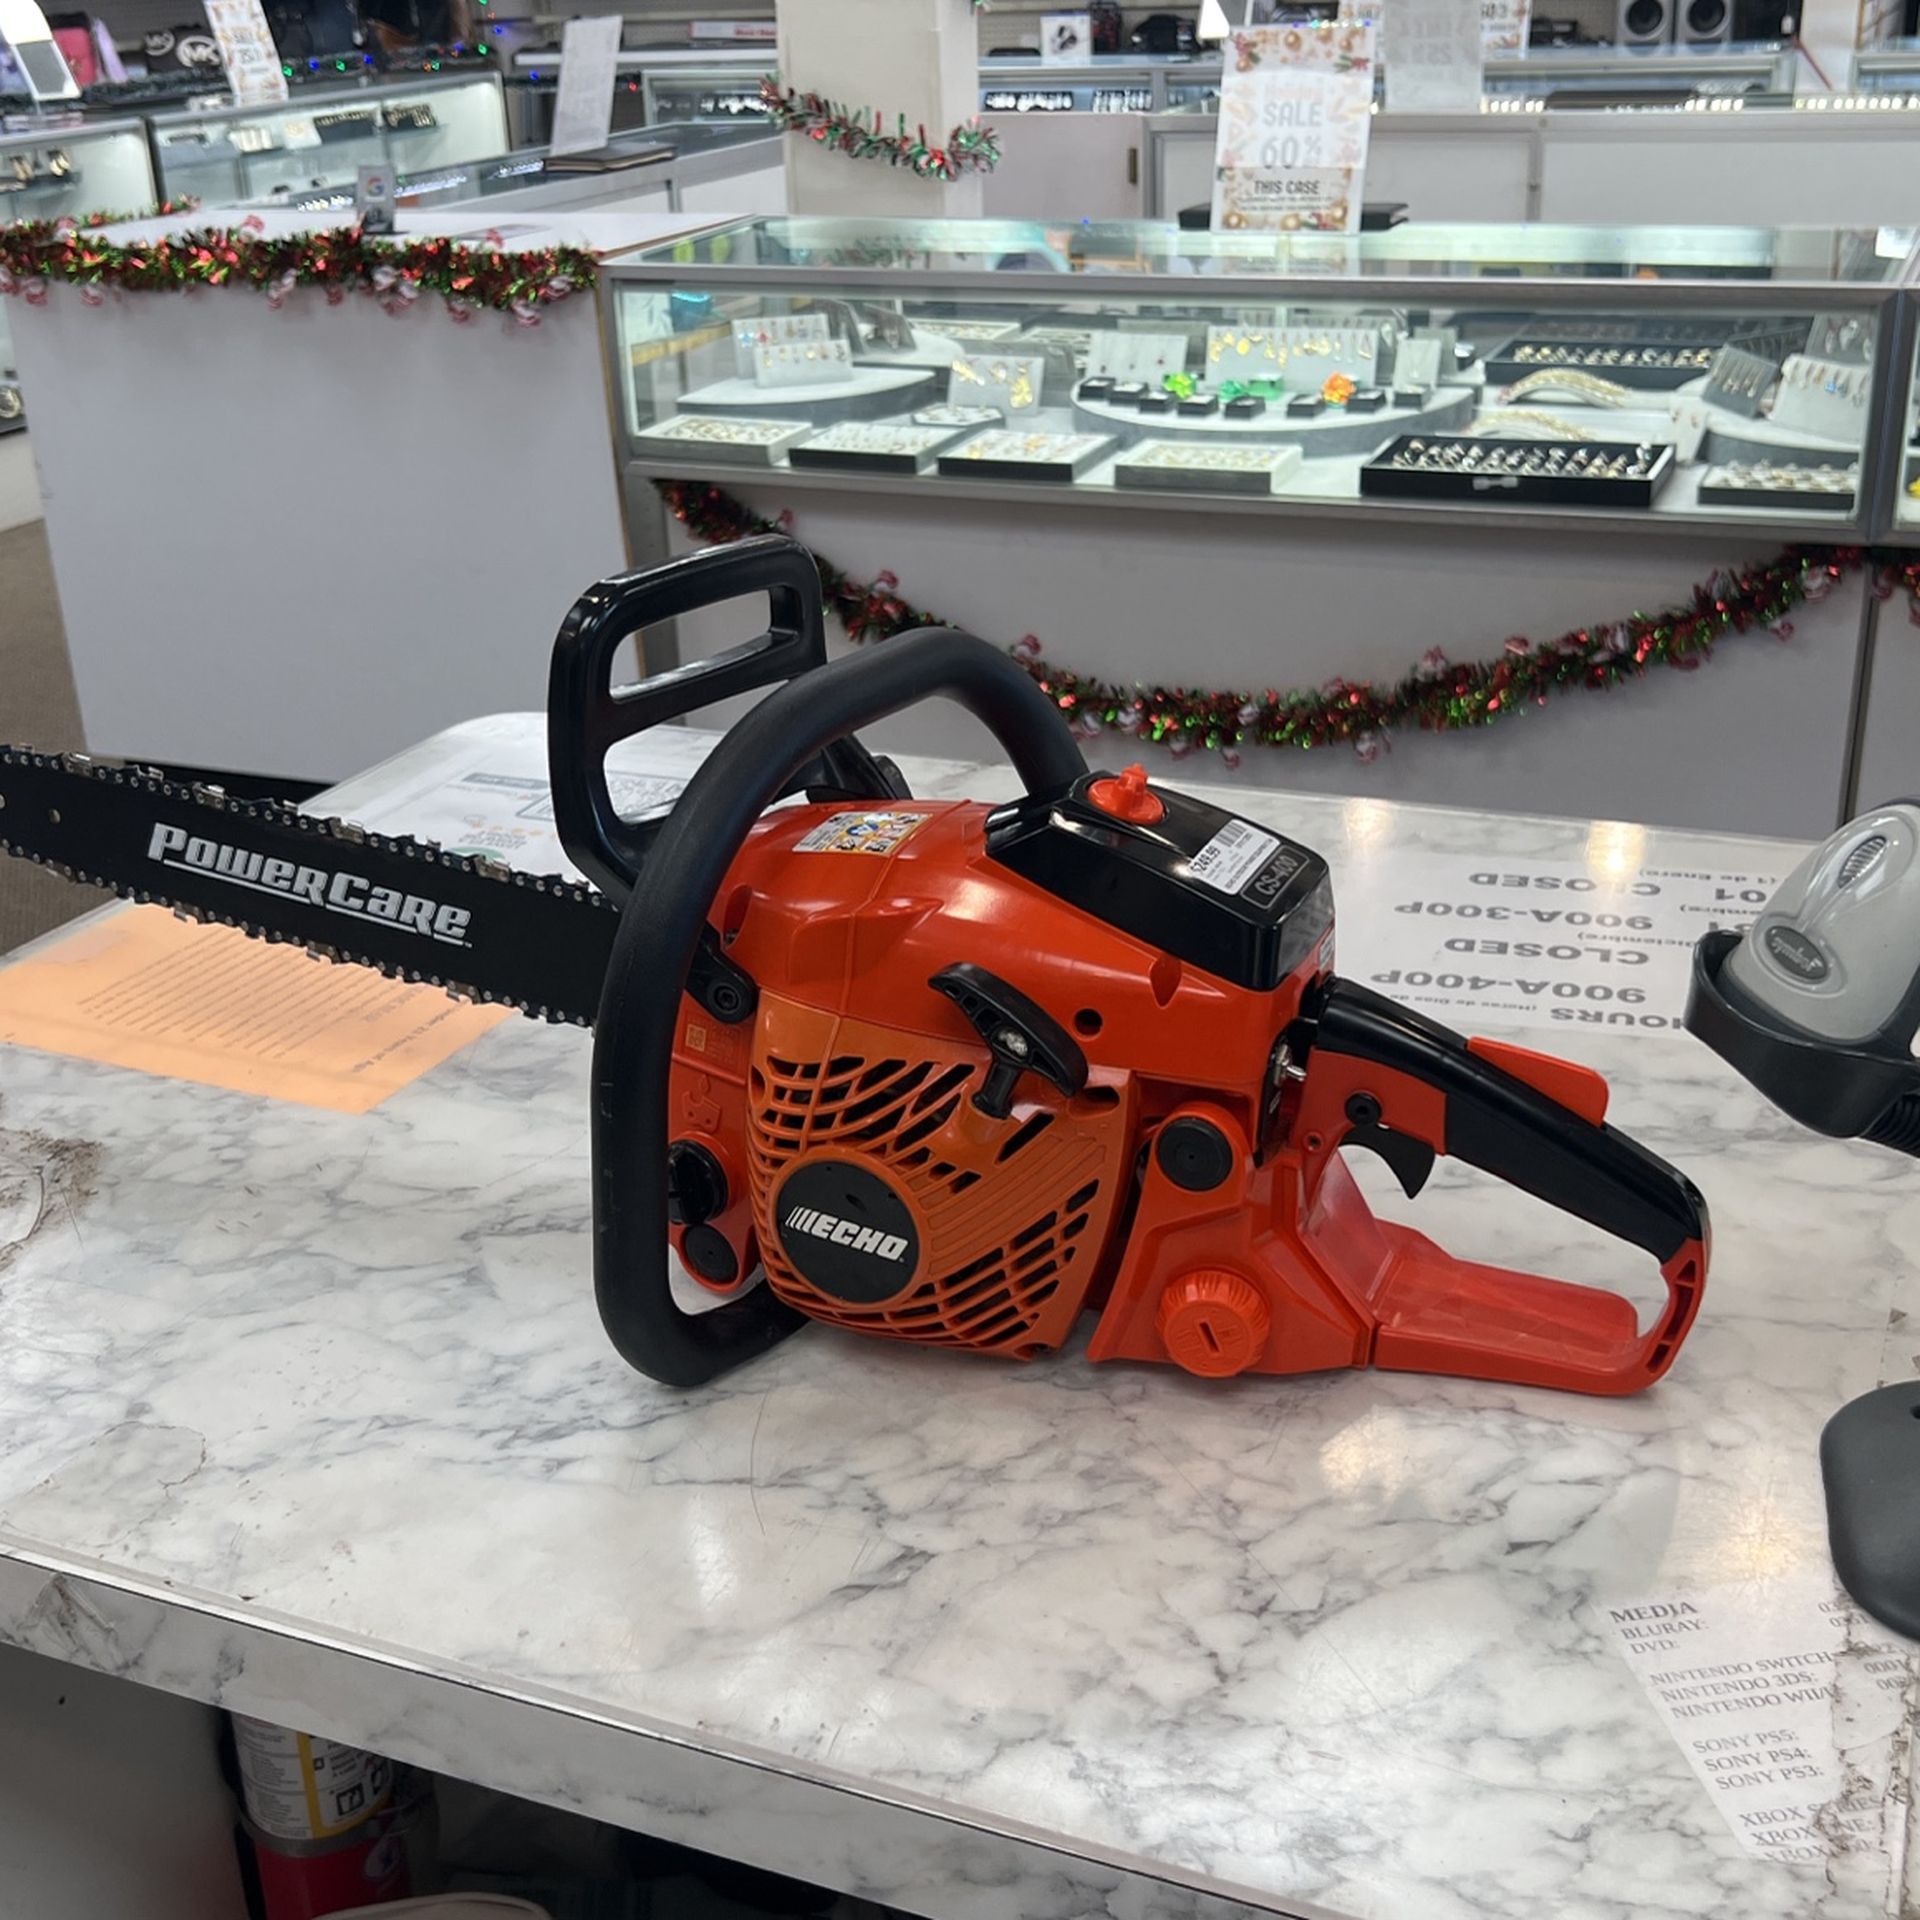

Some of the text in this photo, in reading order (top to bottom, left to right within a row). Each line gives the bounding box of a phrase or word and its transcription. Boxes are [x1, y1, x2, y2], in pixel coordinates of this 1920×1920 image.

[1263, 101, 1323, 127] SALE
[1254, 180, 1320, 195] THIS CASE
[1254, 855, 1298, 895] CS-400
[1469, 872, 1767, 903] 01 COSED
[1394, 901, 1653, 930] 900A-300P
[1444, 937, 1649, 966] CLOSED
[1371, 970, 1646, 1004] 900A-400P
[811, 1213, 909, 1262] ECHO
[1609, 1601, 1698, 1623] MEDIA
[1620, 1619, 1710, 1640] BLURAY:
[1649, 1651, 1833, 1685] NINTENDO SWITCH
[1660, 1671, 1818, 1702] NINTENDO 3DS:
[1671, 1694, 1781, 1719] NINTENDO
[1691, 1729, 1799, 1754] SONY PS5:
[1704, 1747, 1812, 1772] SONY PS4:
[1715, 1765, 1824, 1790] SONY PS3:
[1739, 1805, 1806, 1827] XBOX
[1751, 1824, 1818, 1847] XBOX
[1764, 1844, 1827, 1862] XBOX
